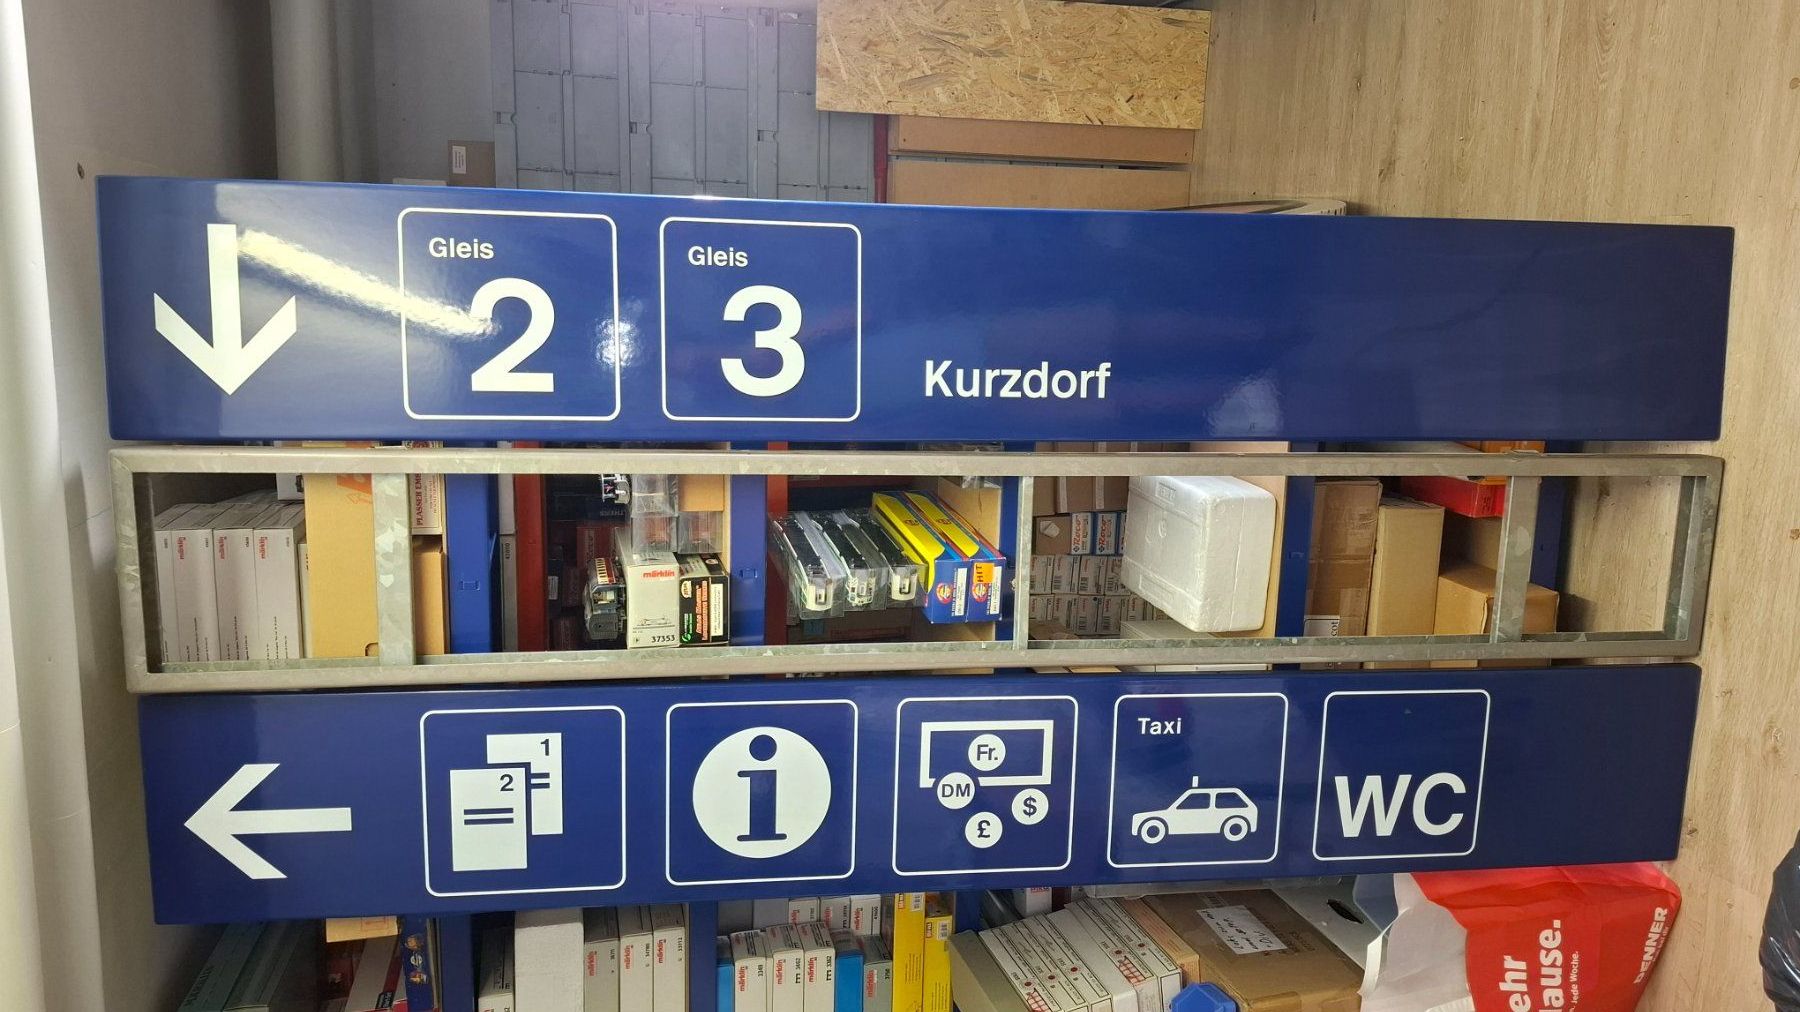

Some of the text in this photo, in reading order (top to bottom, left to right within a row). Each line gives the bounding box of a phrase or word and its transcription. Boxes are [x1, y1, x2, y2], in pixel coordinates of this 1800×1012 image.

[428, 237, 494, 260] Gleis
[687, 246, 748, 268] Gleis
[470, 278, 555, 393] 2
[720, 285, 805, 397] 3
[925, 360, 1112, 399] Kurzdorf
[642, 569, 675, 579] märklin
[975, 564, 984, 582] HIT
[651, 635, 675, 643] 37353
[1138, 717, 1182, 735] Taxi
[540, 738, 550, 756] 1
[976, 742, 999, 763] Fr.
[500, 773, 514, 792] 2
[942, 784, 971, 798] DM
[1334, 772, 1466, 838] WC
[656, 939, 664, 964] märklin
[1633, 906, 1668, 984] DENNER
[807, 957, 815, 983] märklin
[1569, 951, 1580, 983] Woche.
[738, 966, 746, 992] märklin
[1569, 984, 1579, 1004] Jede
